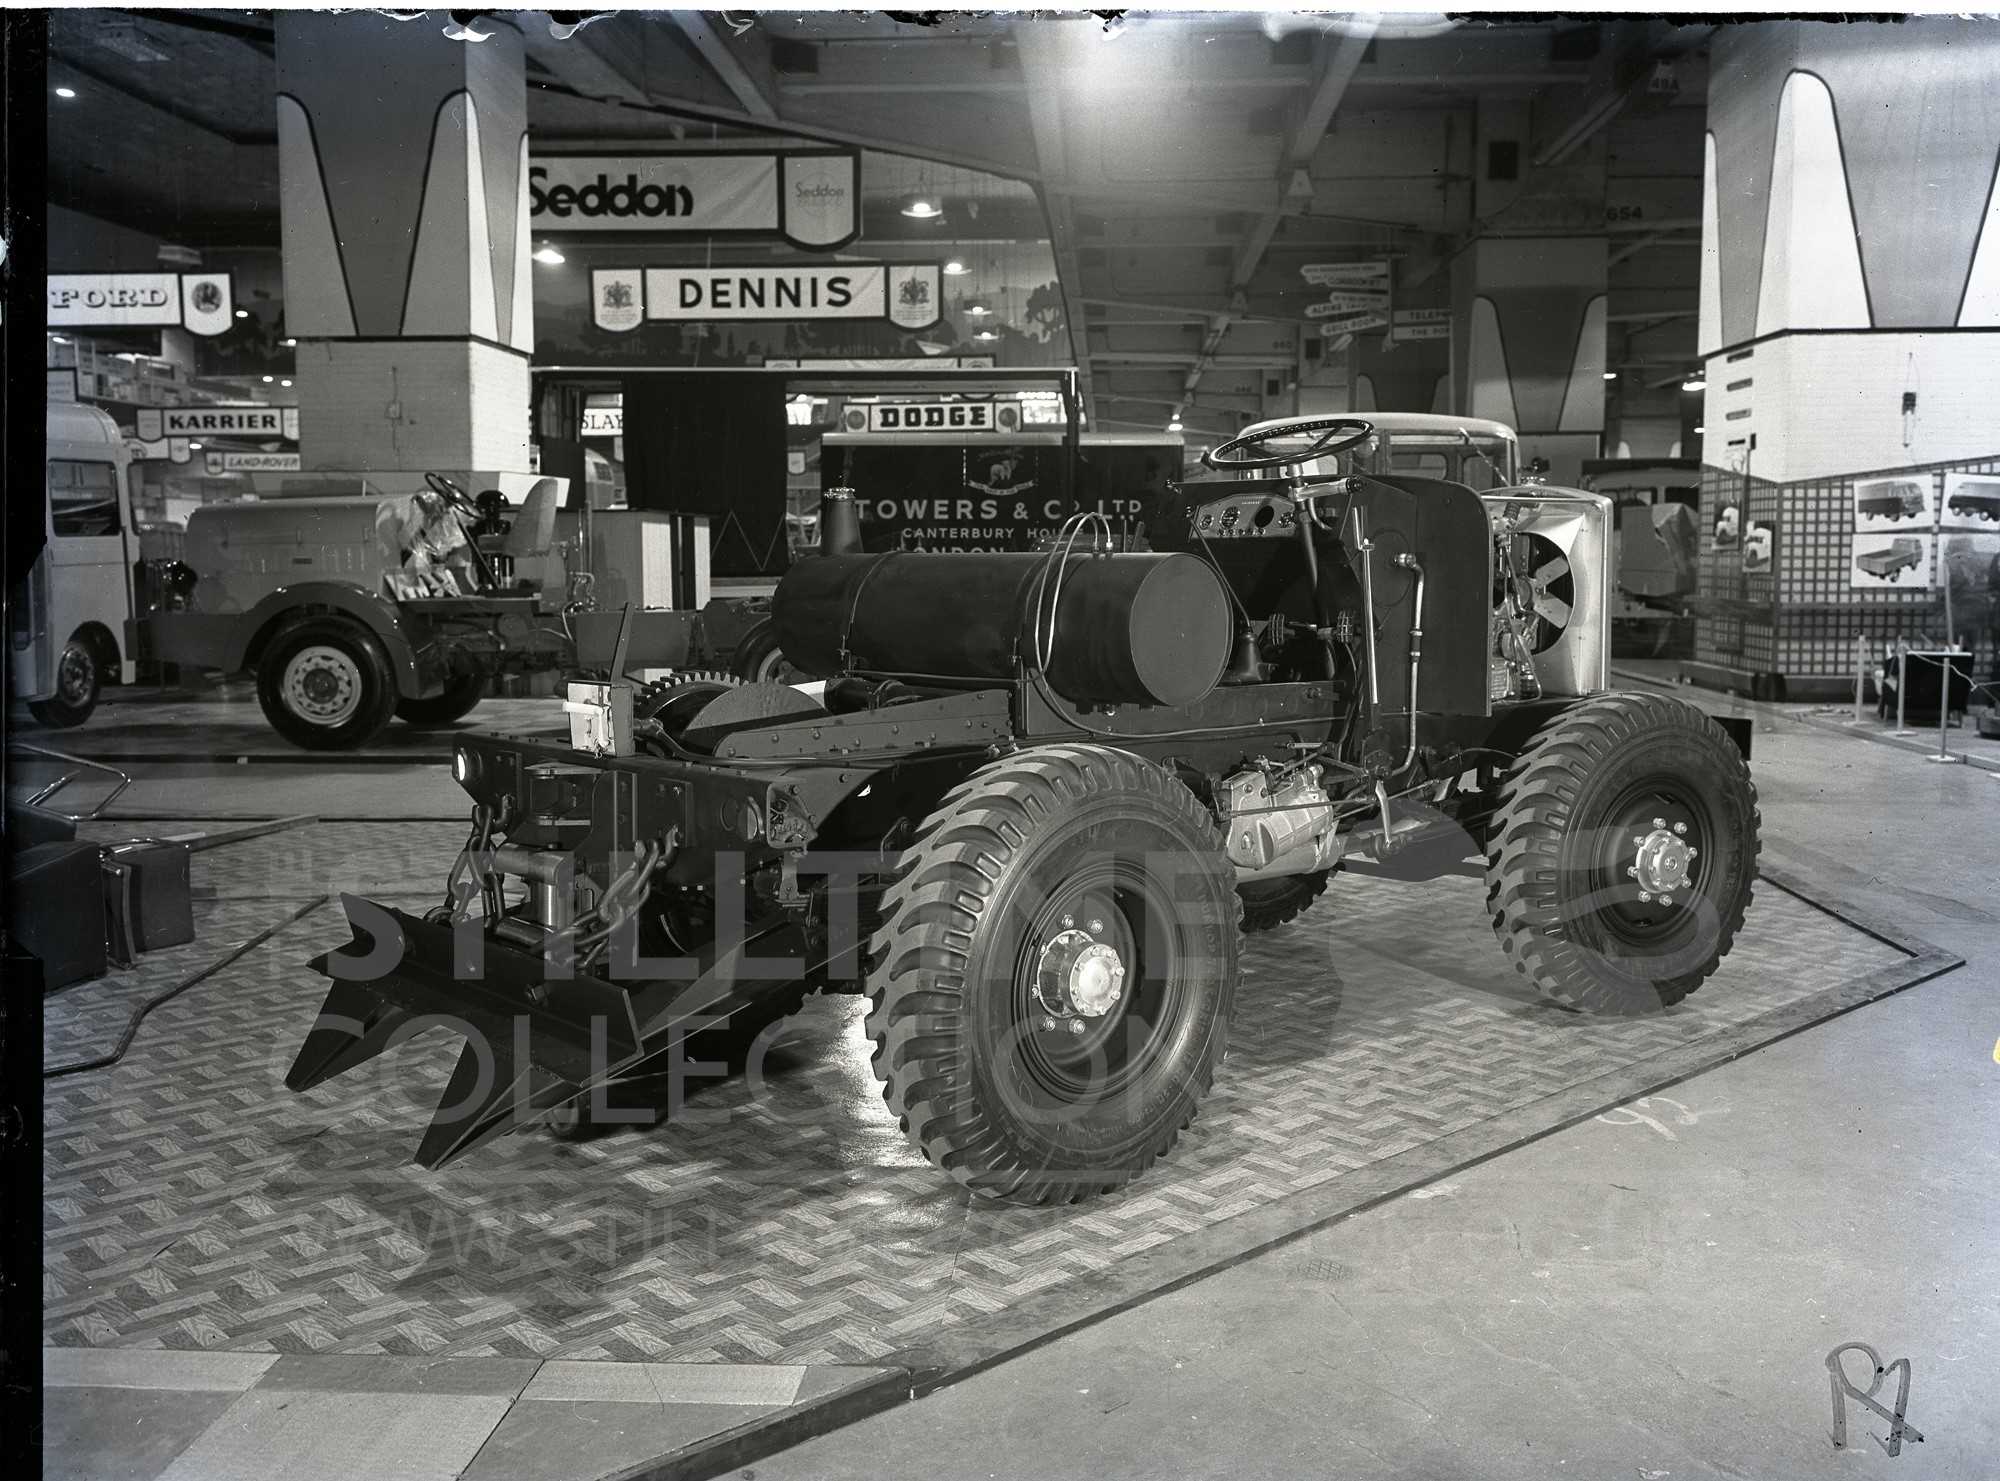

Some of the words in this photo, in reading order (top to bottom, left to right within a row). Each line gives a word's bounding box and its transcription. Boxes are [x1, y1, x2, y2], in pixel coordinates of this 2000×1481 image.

[529, 166, 694, 218] Seddon
[679, 276, 853, 309] DENNIS
[169, 414, 278, 430] KARRIER
[880, 405, 987, 428] DODGE
[228, 456, 299, 469] LAND-ROVER
[855, 499, 999, 521] TOWERS
[1012, 502, 1030, 520] &
[902, 527, 1015, 539] CANTERBURY
